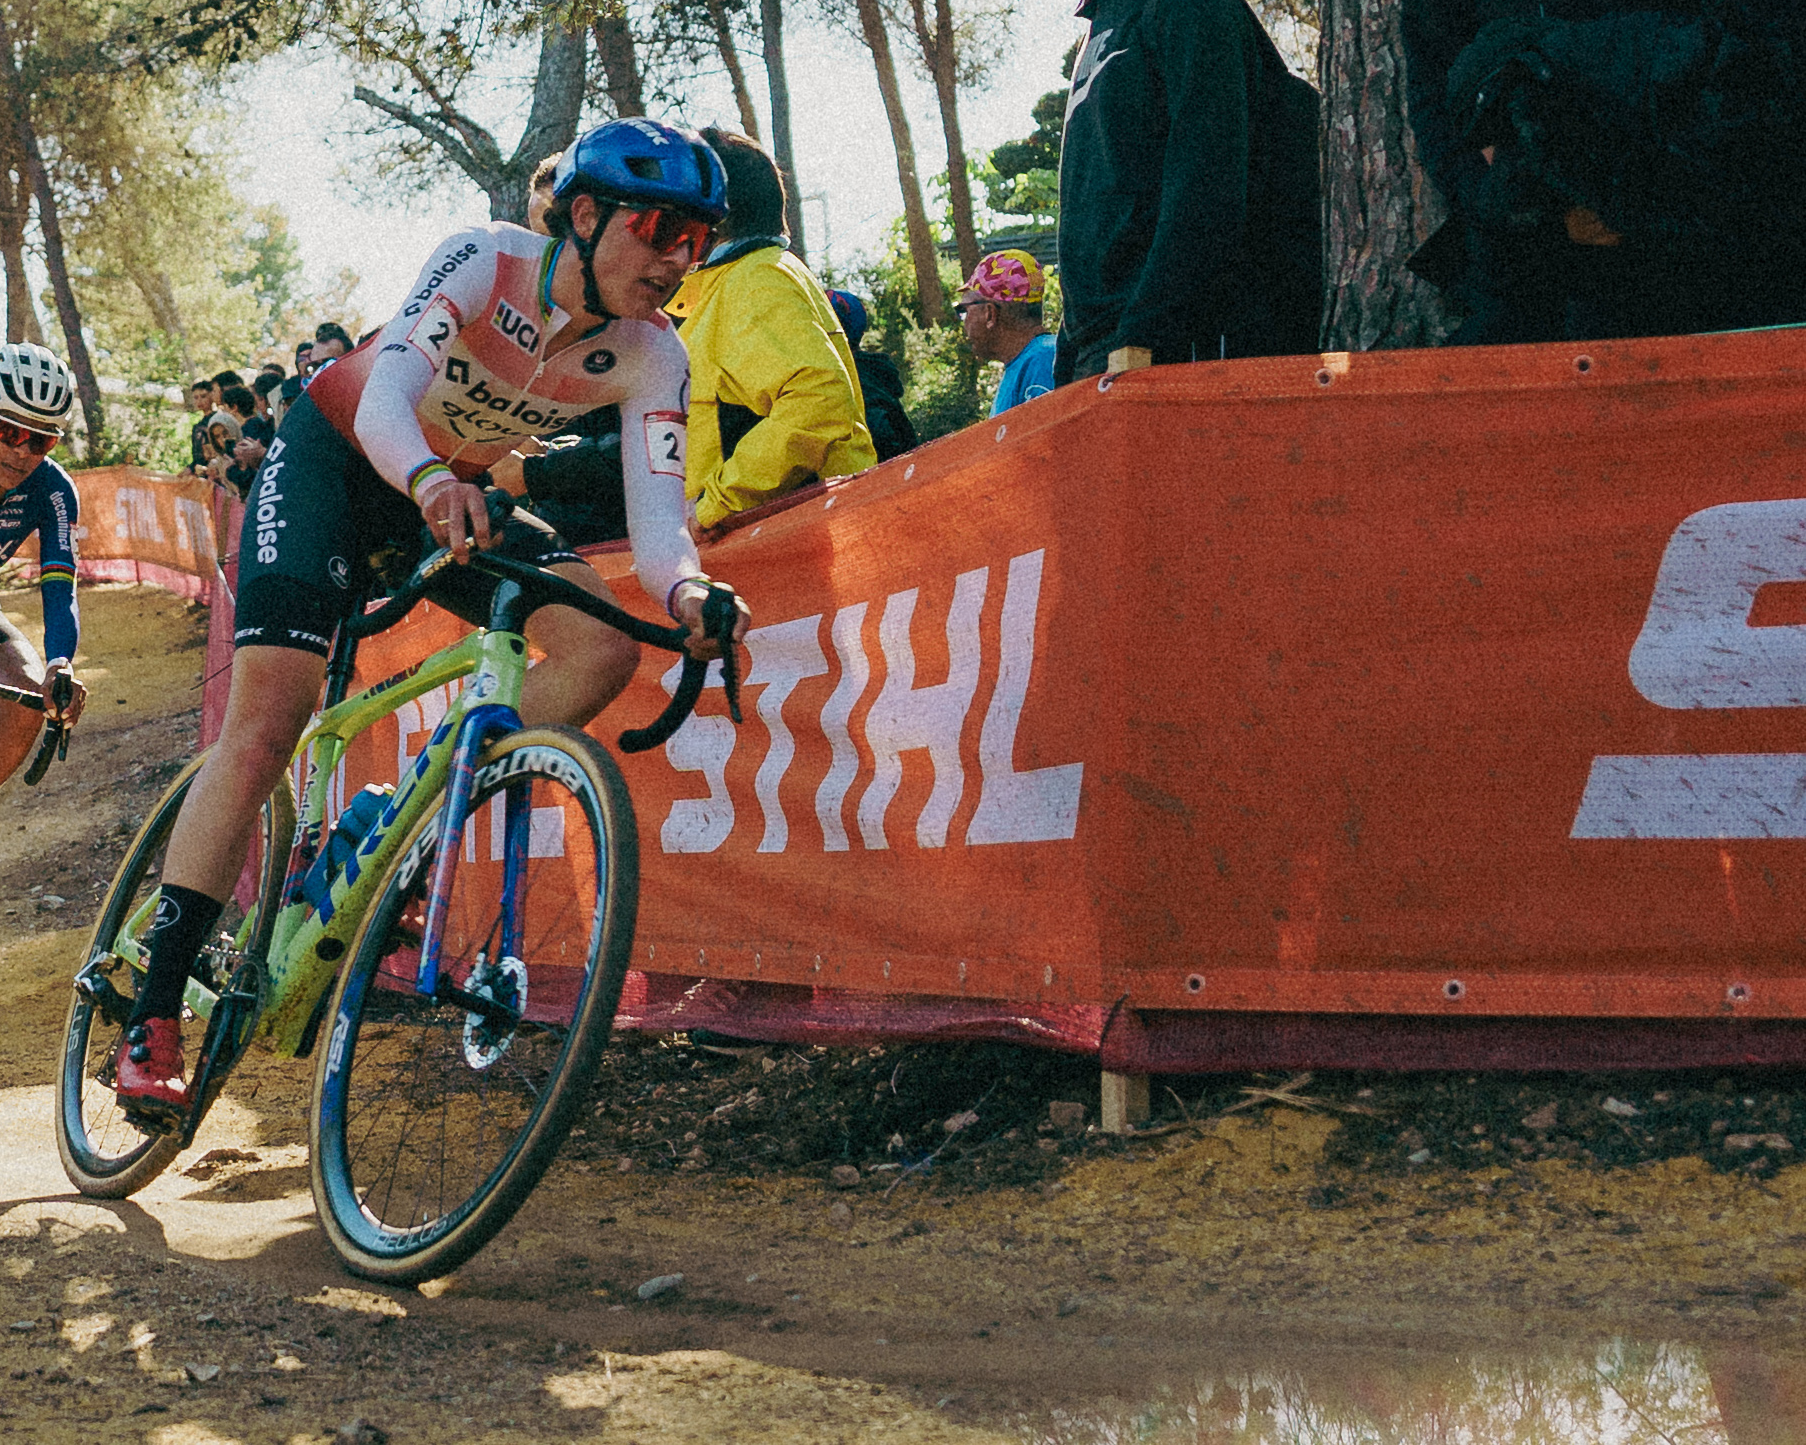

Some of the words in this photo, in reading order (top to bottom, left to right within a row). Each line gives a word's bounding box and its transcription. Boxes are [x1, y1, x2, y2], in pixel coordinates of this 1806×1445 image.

[414, 242, 479, 301] baloise
[428, 321, 450, 352] 2
[500, 309, 540, 354] UCI
[663, 431, 681, 462] 2
[49, 490, 70, 552] deceuninck
[255, 461, 287, 564] baloise
[660, 548, 1084, 855] STIHL
